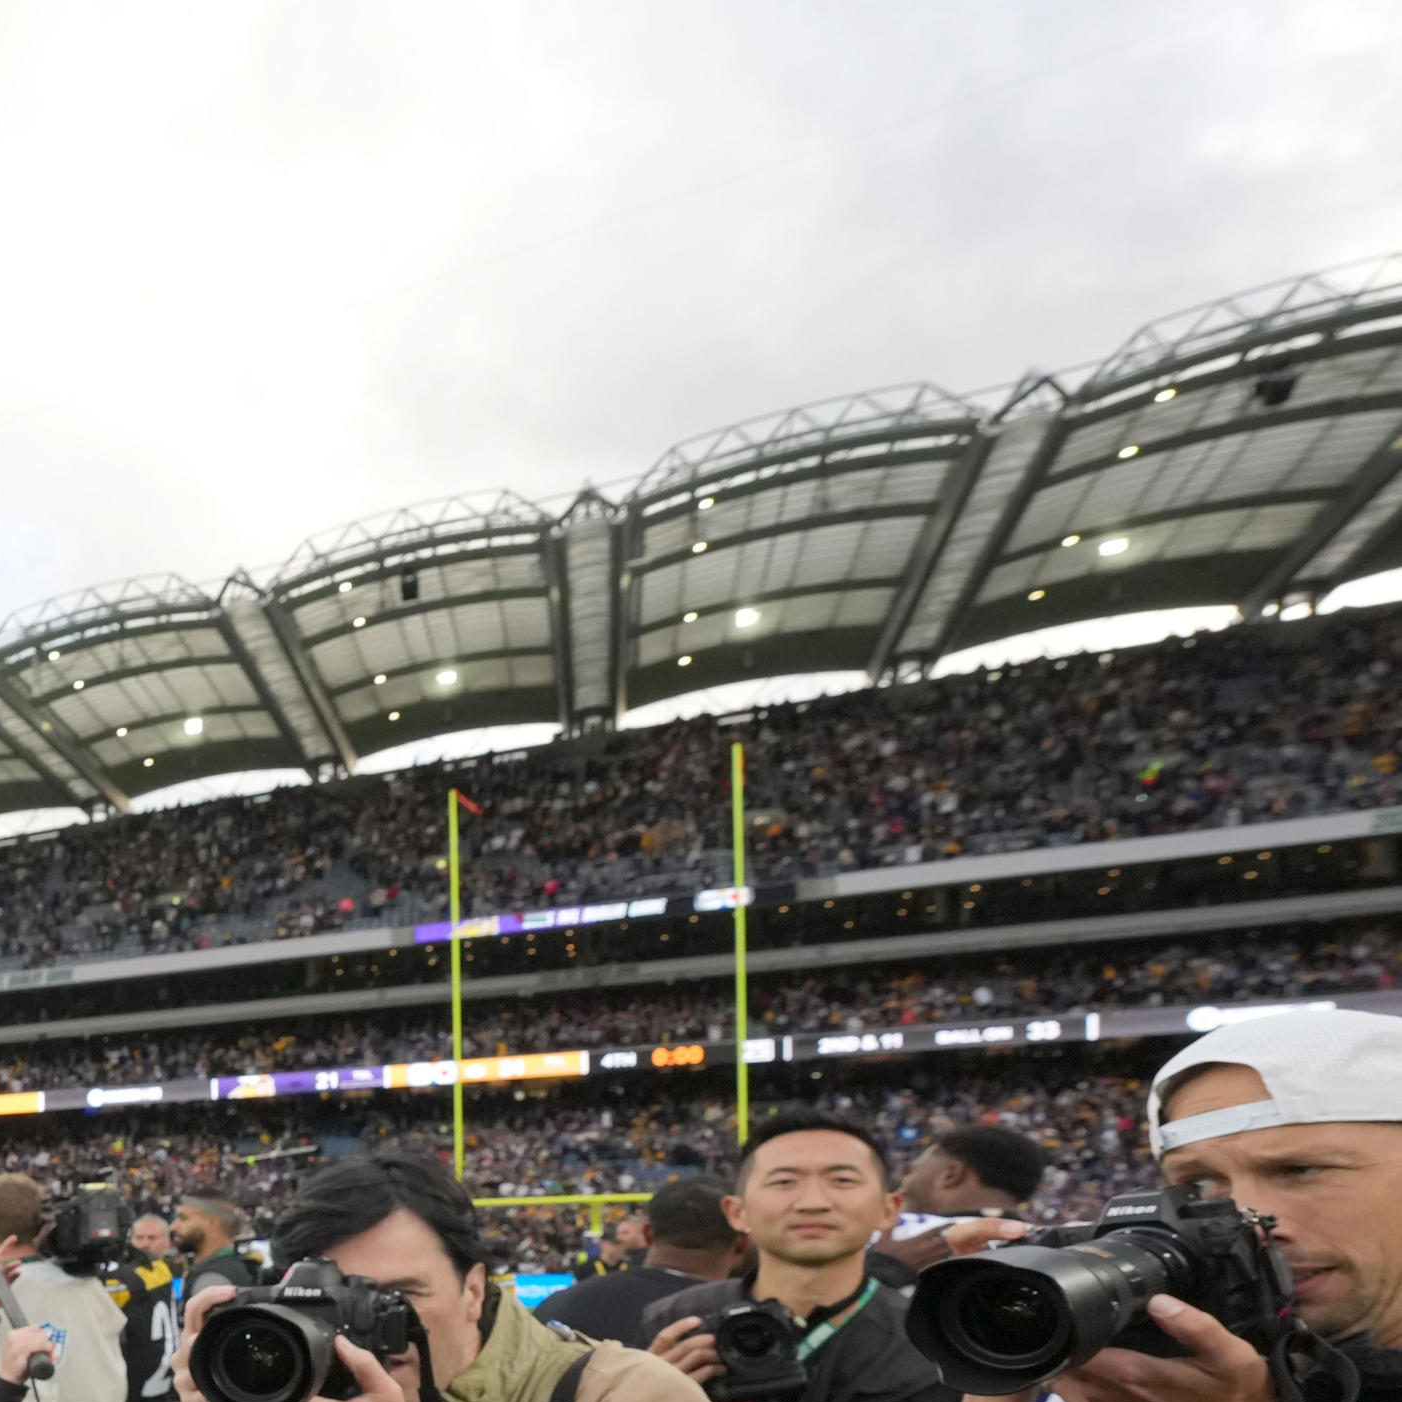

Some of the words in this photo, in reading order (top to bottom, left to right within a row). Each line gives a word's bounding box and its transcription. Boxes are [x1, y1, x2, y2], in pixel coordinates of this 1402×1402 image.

[1105, 1204, 1158, 1218] Nikon
[283, 1286, 323, 1298] Nikon
[140, 1292, 182, 1398] 2
